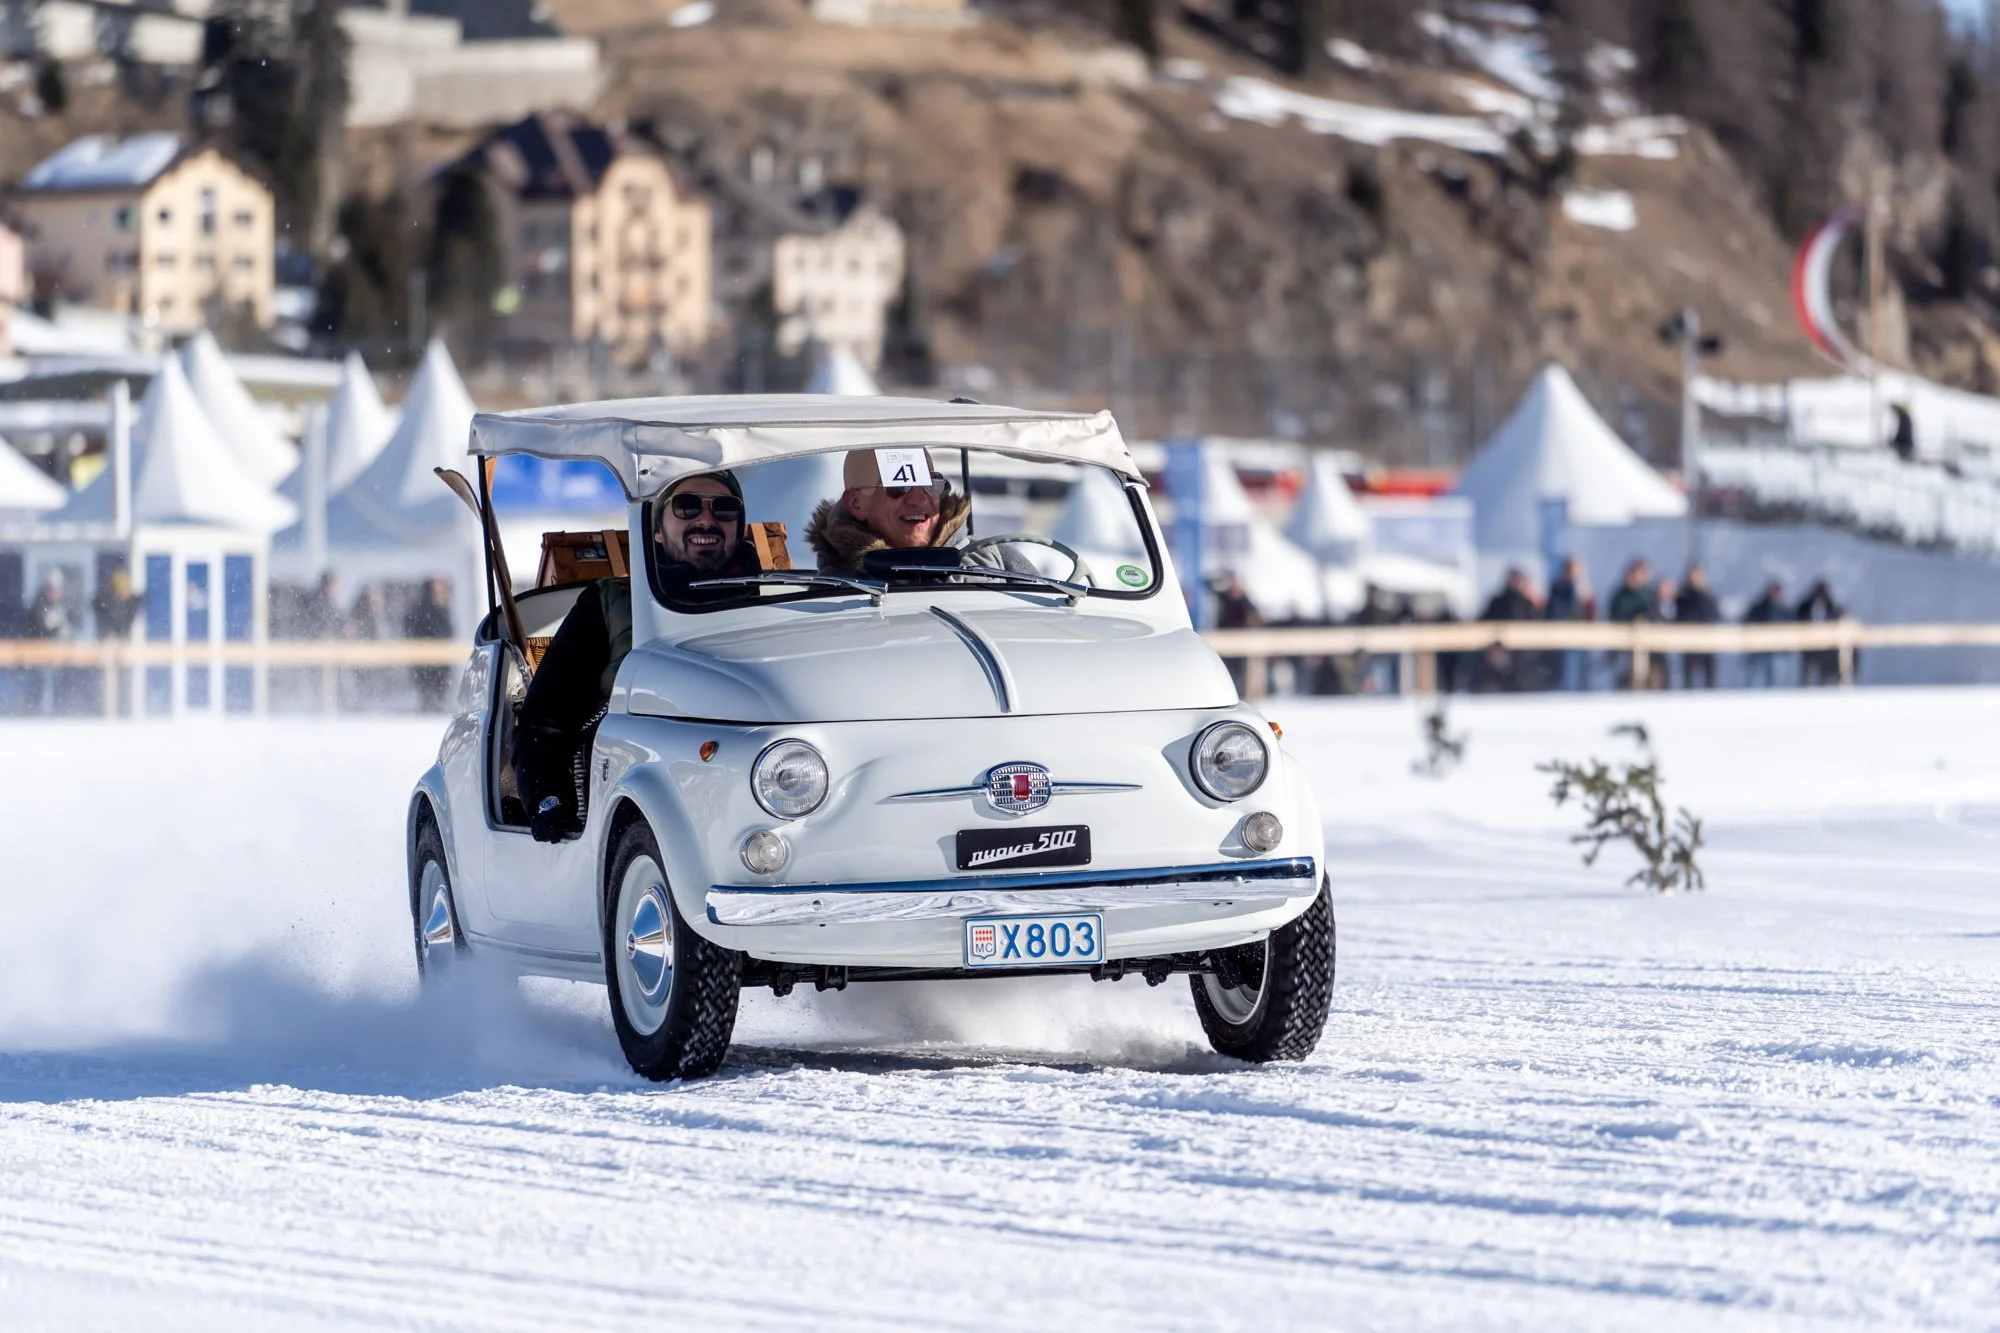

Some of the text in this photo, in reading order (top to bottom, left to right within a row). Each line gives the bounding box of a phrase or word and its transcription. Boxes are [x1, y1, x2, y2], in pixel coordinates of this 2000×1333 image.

[892, 464, 917, 482] 41
[968, 829, 1077, 867] nuova 500
[975, 943, 994, 953] MC
[1002, 921, 1095, 959] X803
